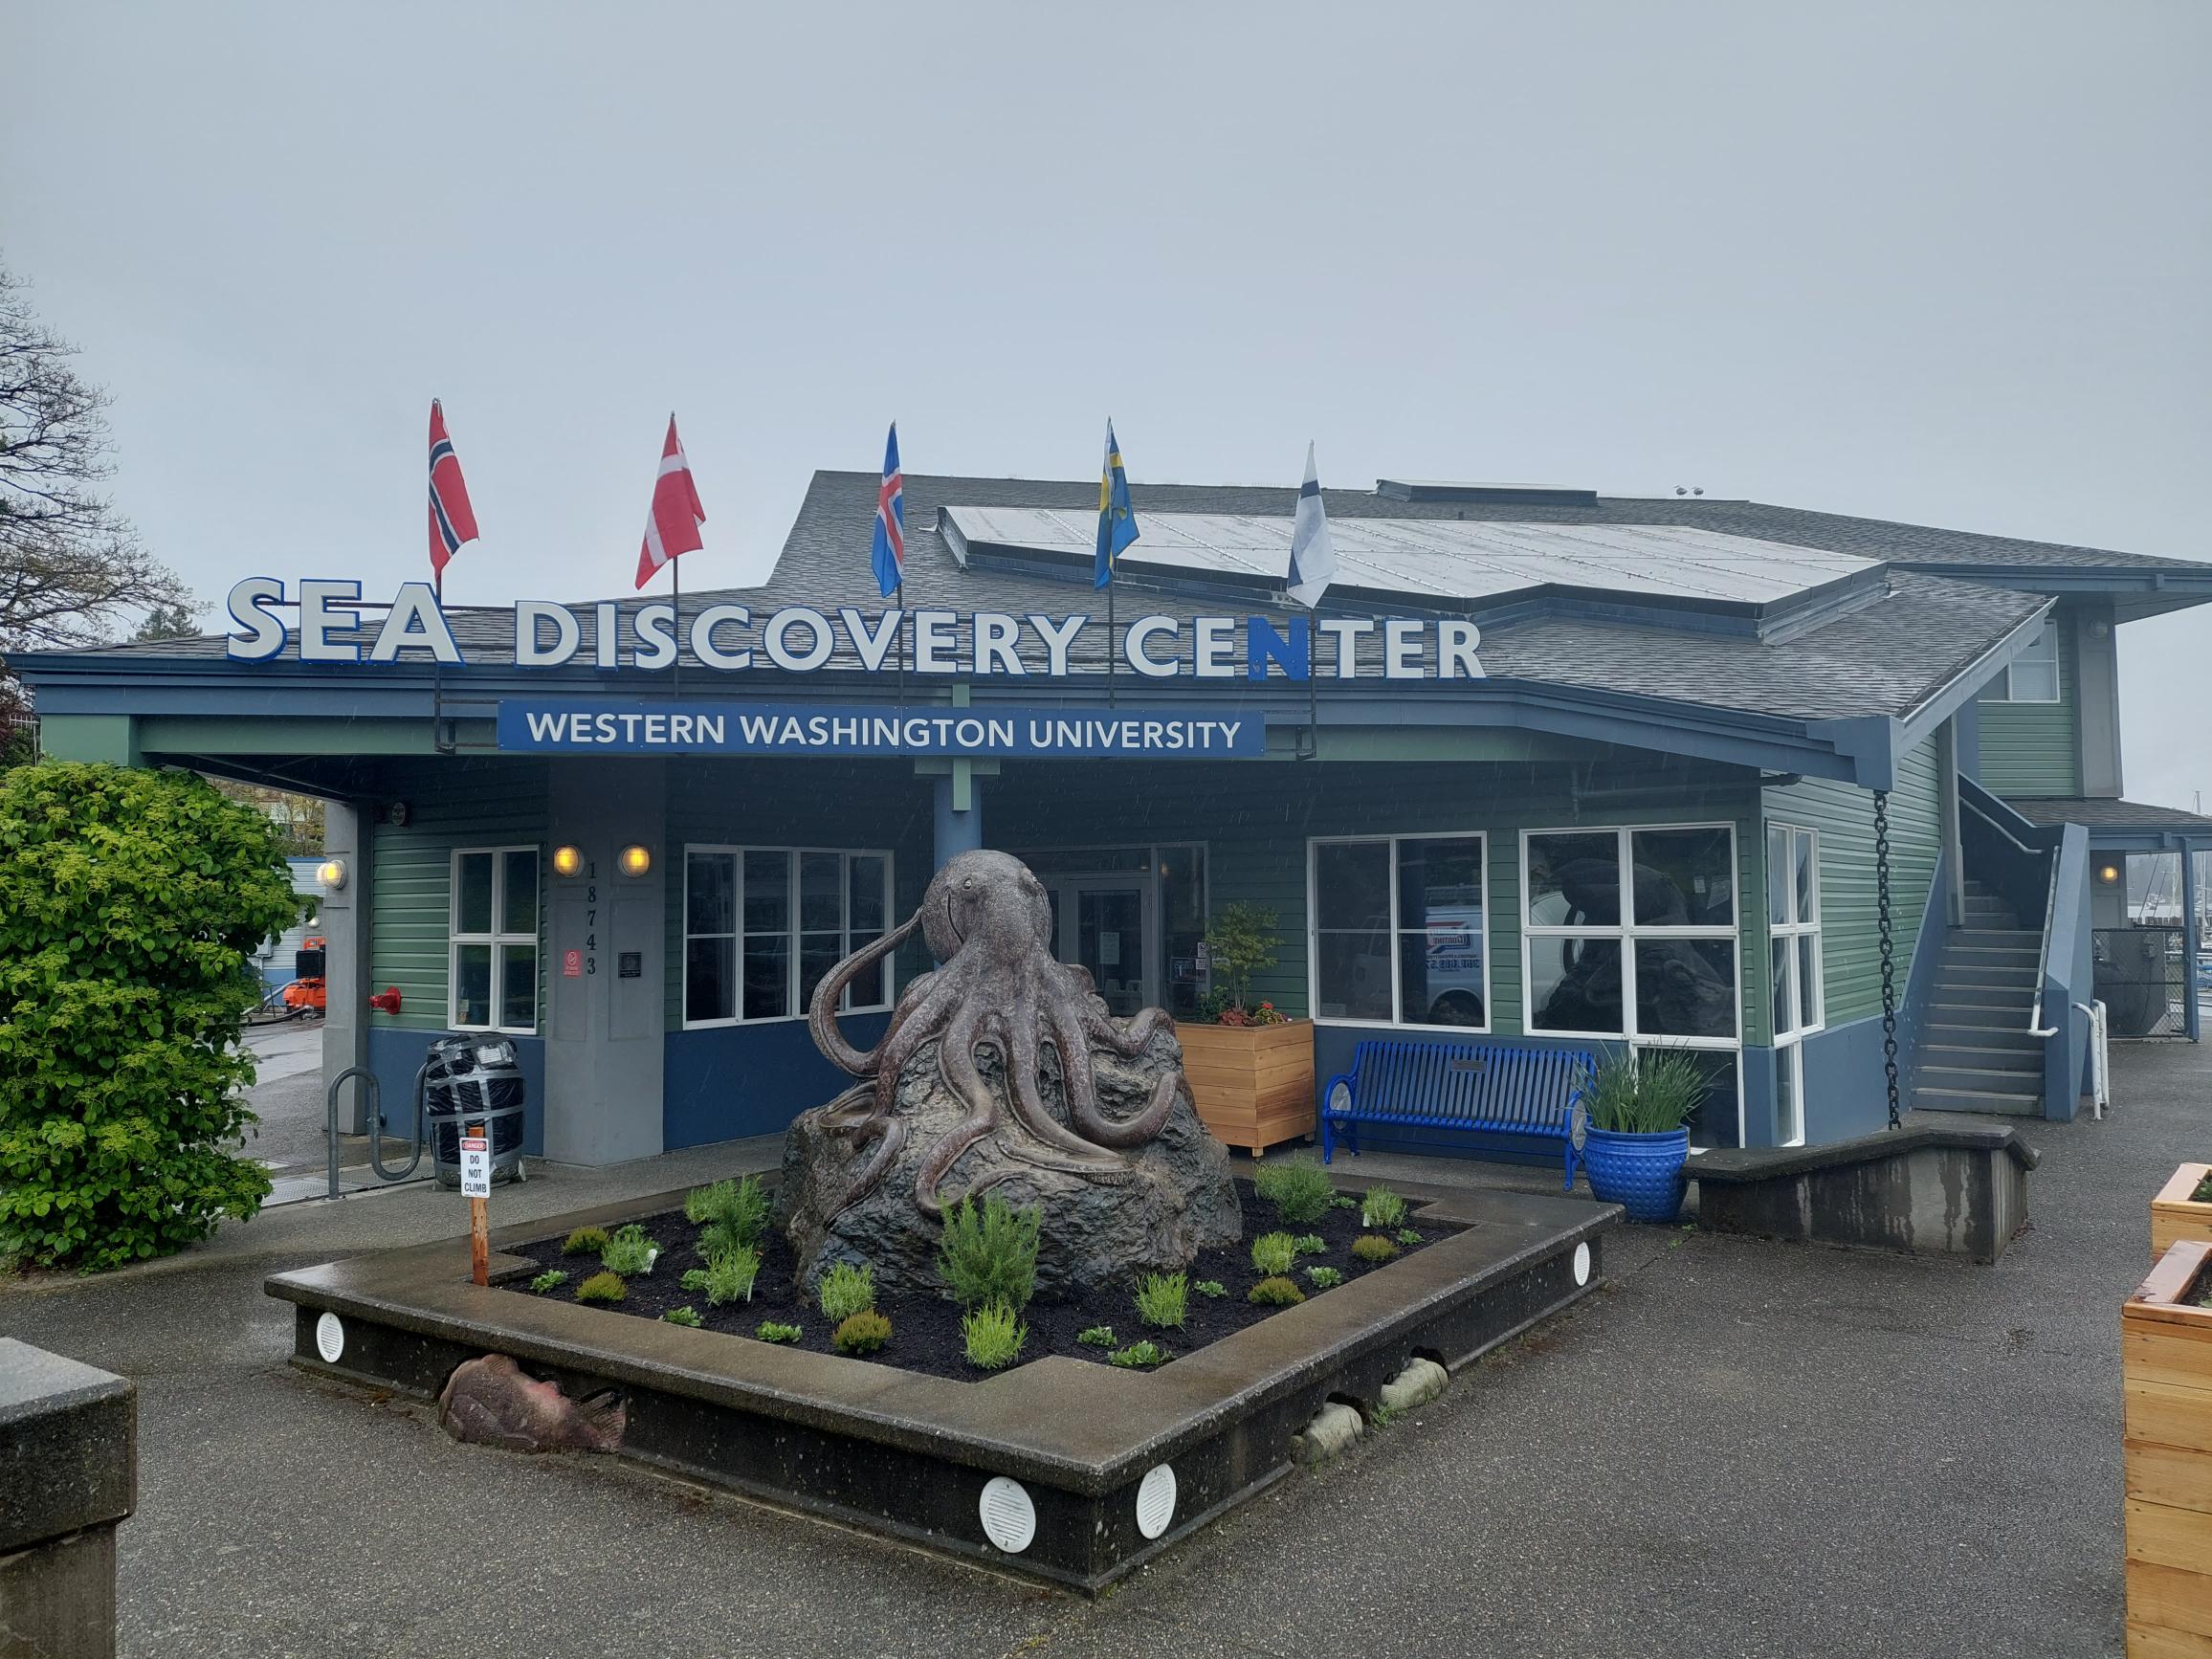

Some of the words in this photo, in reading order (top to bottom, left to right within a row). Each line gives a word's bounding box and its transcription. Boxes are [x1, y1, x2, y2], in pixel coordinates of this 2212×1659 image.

[227, 577, 465, 665] SEA
[514, 599, 1090, 678] DISCOVERY
[1124, 613, 1489, 683] CENTER
[525, 711, 726, 745] WESTERN
[738, 715, 1016, 750] WASHINGTON
[1028, 719, 1242, 750] UNIVERSITY
[586, 861, 597, 975] 18743
[469, 1155, 480, 1164] DO
[468, 1169, 482, 1179] NOT
[464, 1182, 487, 1193] CLIMB
